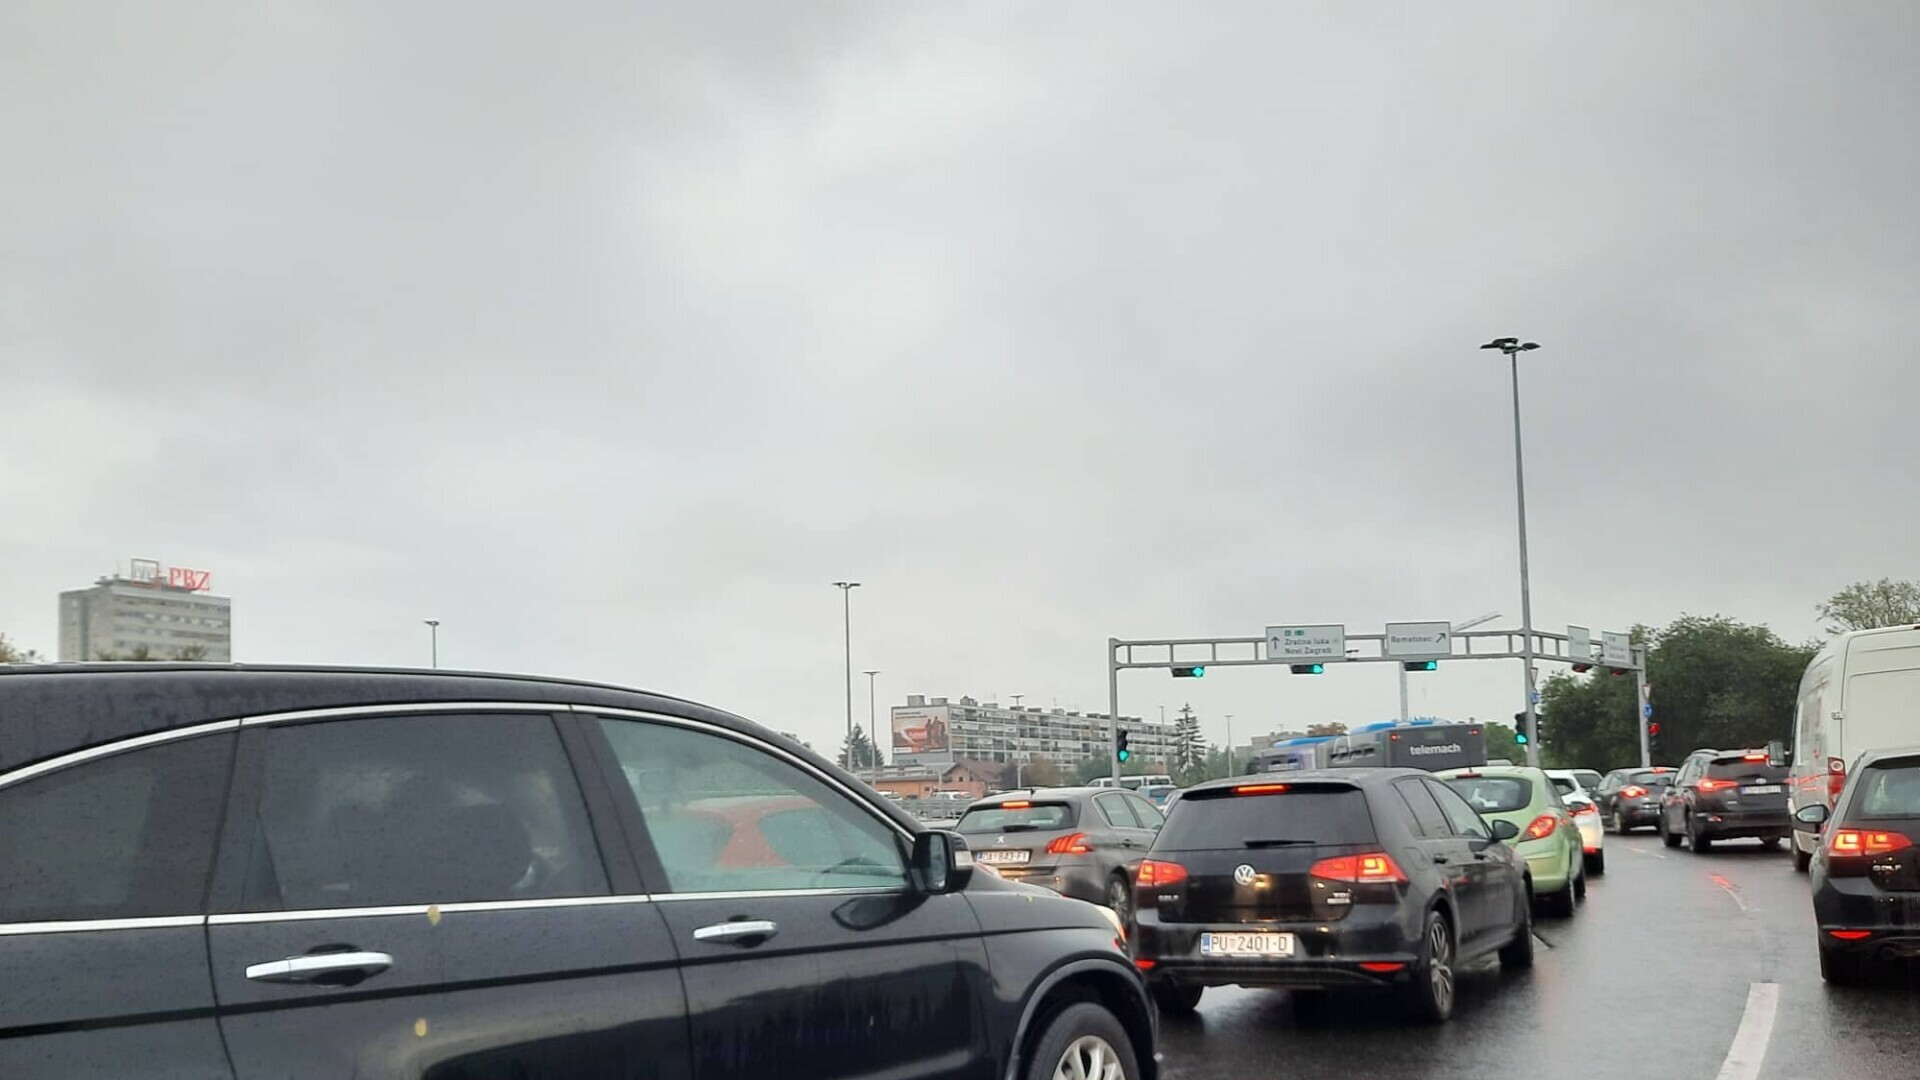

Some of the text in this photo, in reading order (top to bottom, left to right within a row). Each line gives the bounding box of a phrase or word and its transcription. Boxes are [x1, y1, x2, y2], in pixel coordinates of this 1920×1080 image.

[168, 567, 211, 591] PBZ
[1410, 742, 1461, 756] telemach
[1211, 935, 1288, 951] PU 2401-D
